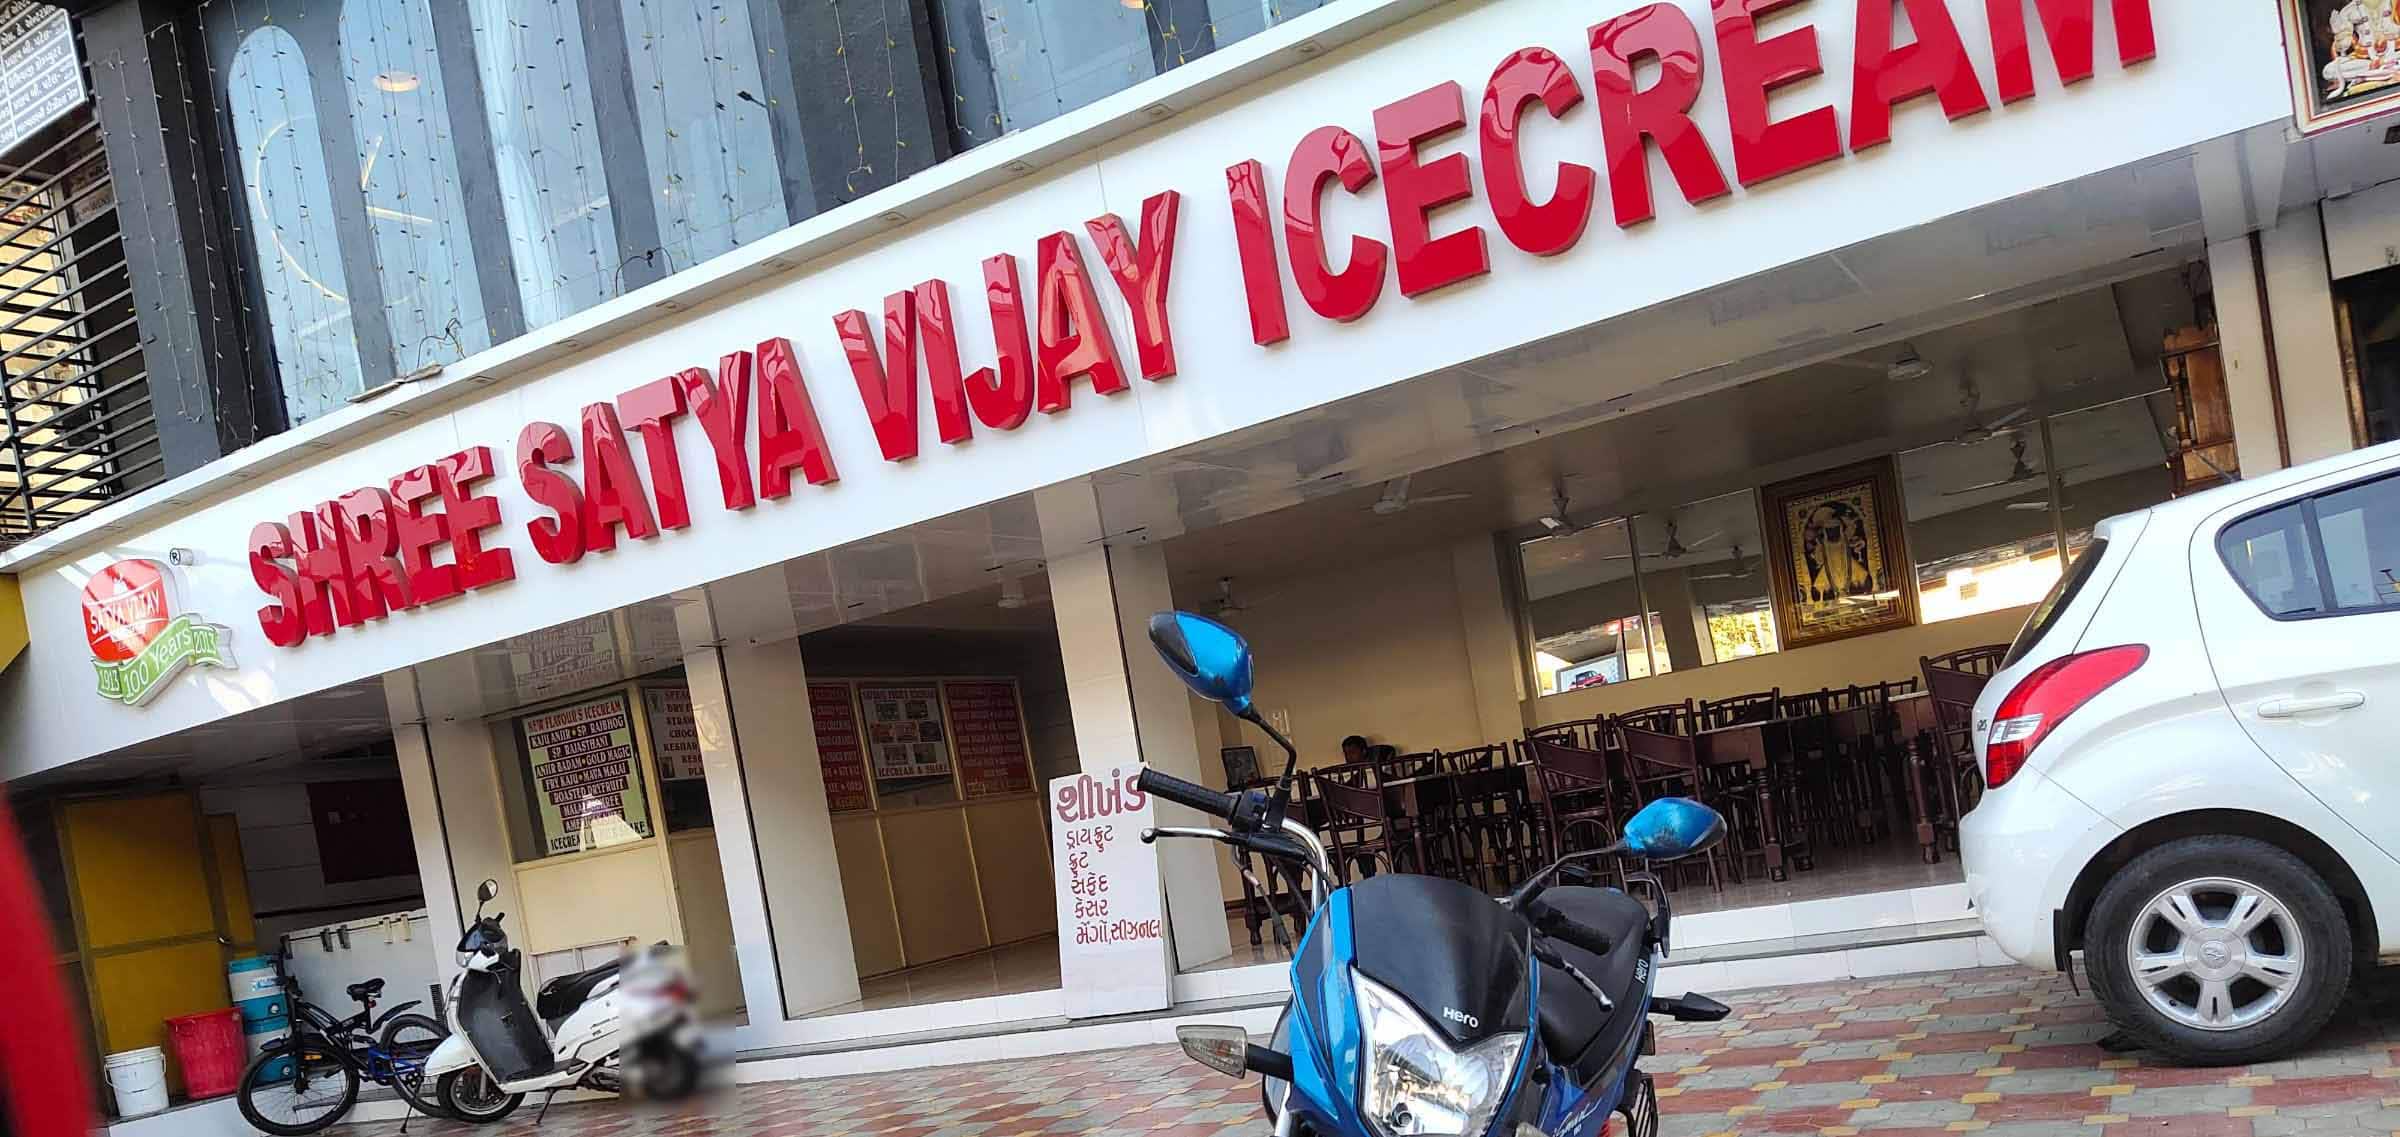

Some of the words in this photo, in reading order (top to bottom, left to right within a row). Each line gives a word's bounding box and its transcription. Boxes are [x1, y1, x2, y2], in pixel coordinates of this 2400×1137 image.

[248, 446, 516, 647] SHREE
[517, 337, 840, 564] SATYA
[832, 190, 1180, 462] VIJAY
[193, 631, 217, 654] 2013
[124, 663, 149, 697] 100
[151, 629, 192, 671] Years
[100, 669, 120, 692] 1913
[584, 700, 622, 718] ICECREAM
[531, 734, 550, 748] KAJU
[551, 729, 571, 741] ANJIR
[590, 716, 624, 734] RAJBHOG
[666, 716, 694, 726] STRAW
[564, 735, 609, 756] RAJASTHANI
[557, 758, 582, 772] BADAM
[586, 752, 606, 765] GOLD
[607, 746, 630, 760] MAGIC
[560, 774, 578, 787] KAJU
[583, 768, 602, 782] MAVA
[603, 763, 626, 777] MALAI
[587, 779, 624, 796] DRYFRUIT
[1056, 768, 1147, 823] શીખંડ
[551, 834, 587, 851] ICECREA
[1071, 872, 1109, 896] સફેદ
[1074, 896, 1109, 918] કેસર
[1443, 1006, 1479, 1028] Hero
